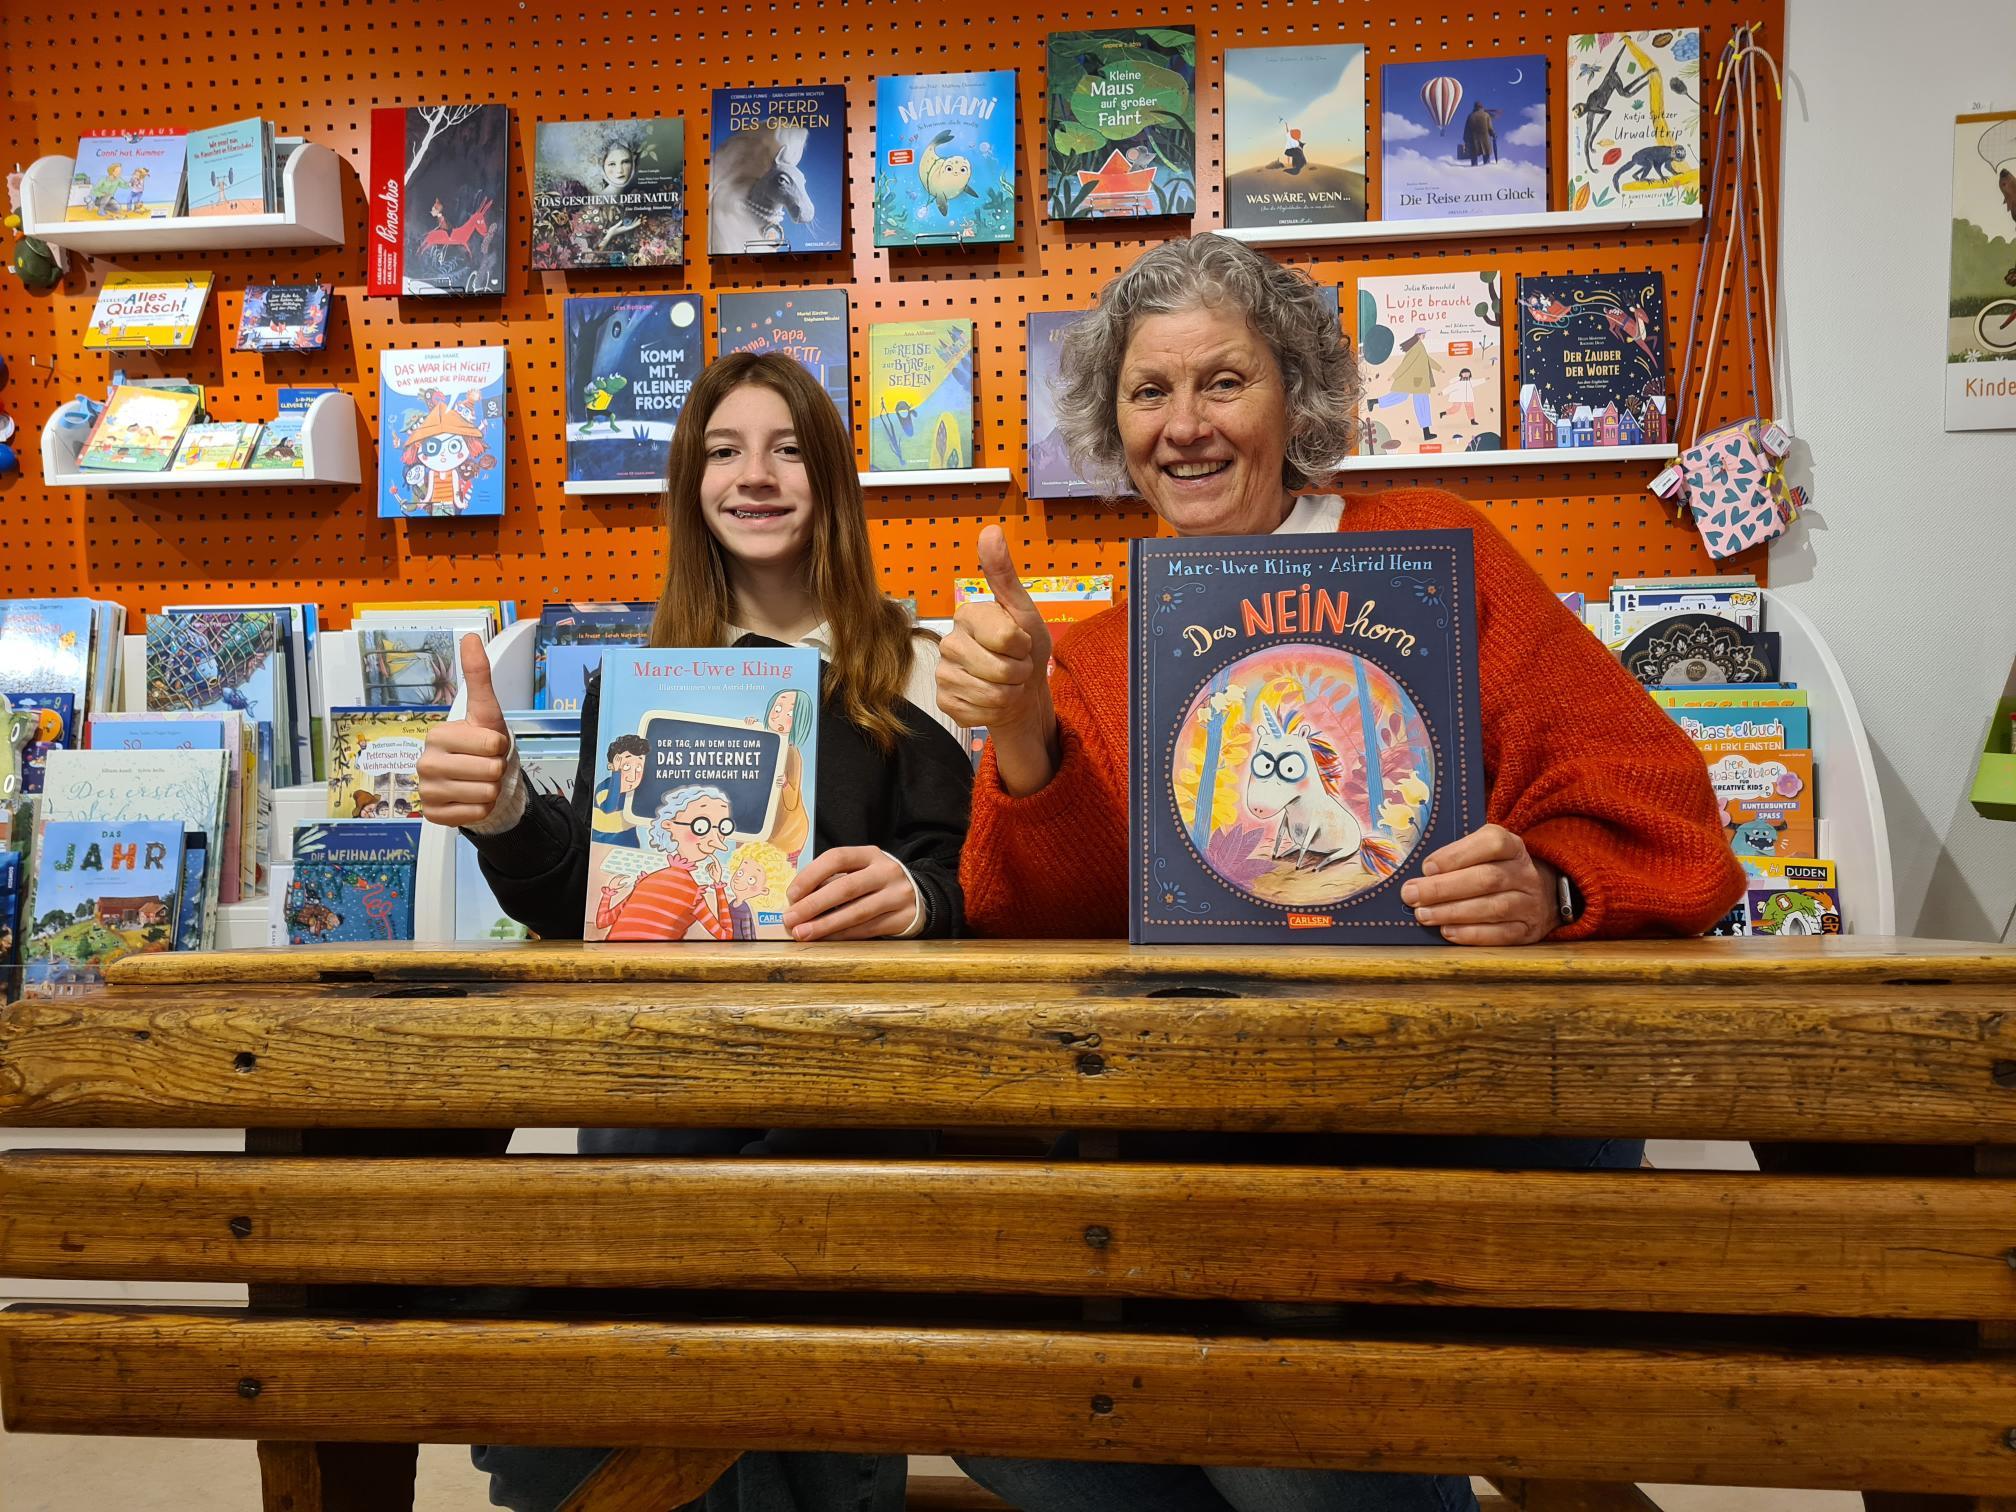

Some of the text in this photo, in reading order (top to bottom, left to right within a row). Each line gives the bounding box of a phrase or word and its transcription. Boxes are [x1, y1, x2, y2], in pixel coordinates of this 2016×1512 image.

[1109, 70, 1142, 81] Kleine
[1090, 81, 1134, 97] Maus
[730, 99, 819, 116] DAS PFERD
[1100, 97, 1158, 111] auf großer
[730, 114, 830, 132] DES GRAFEN
[1098, 110, 1142, 127] Fahrt
[1623, 112, 1678, 123] Katja Spitzer
[1614, 125, 1684, 142] Urwaldtrip
[95, 148, 118, 158] Conni
[135, 148, 166, 158] Kummer
[541, 191, 680, 208] DAS GESCHENK DER NATUR
[1245, 191, 1351, 204] WAS WÄRE, WENN...
[1399, 186, 1536, 206] Die Reise zum Glück
[375, 178, 400, 244] Pinocchio
[125, 291, 167, 306] Alles
[1386, 293, 1472, 309] Luise braucht
[106, 297, 187, 316] Quatsch!
[1387, 310, 1447, 324] 'ne Pause
[772, 328, 807, 344] Papa,
[640, 349, 685, 364] KOMM
[1563, 348, 1622, 363] DER ZAUBER
[394, 363, 415, 377] DAS
[418, 362, 440, 374] WAR
[649, 364, 679, 379] MIT,
[1565, 363, 1621, 378] DER WORTE
[397, 378, 411, 388] DAS
[413, 375, 438, 385] WAREN
[888, 371, 932, 388] SEELEN
[633, 380, 693, 395] KLEINER
[635, 396, 686, 411] FROSC
[1167, 554, 1433, 577] Marc-Uwe Kling Astrid Henn
[1614, 613, 1622, 636] TOPP
[1182, 624, 1237, 657] Das
[632, 660, 793, 680] Marc-Uwe Kling
[722, 683, 744, 691] Astrid
[745, 683, 765, 691] Henn
[1681, 717, 1698, 728] Das
[657, 739, 761, 749] DER TAG, AN DEM DIE OMA
[657, 751, 761, 766] DAS INTERNET
[656, 769, 760, 779] KAPUTT GEMACHT HAT
[126, 783, 184, 801] erste
[1741, 802, 1797, 810] KUNTERBUNTER
[1758, 811, 1781, 820] SPASS
[101, 830, 122, 839] DAS
[54, 841, 168, 872] JAHR
[1786, 866, 1827, 878] DUDEN
[1290, 915, 1330, 925] CARLSEN
